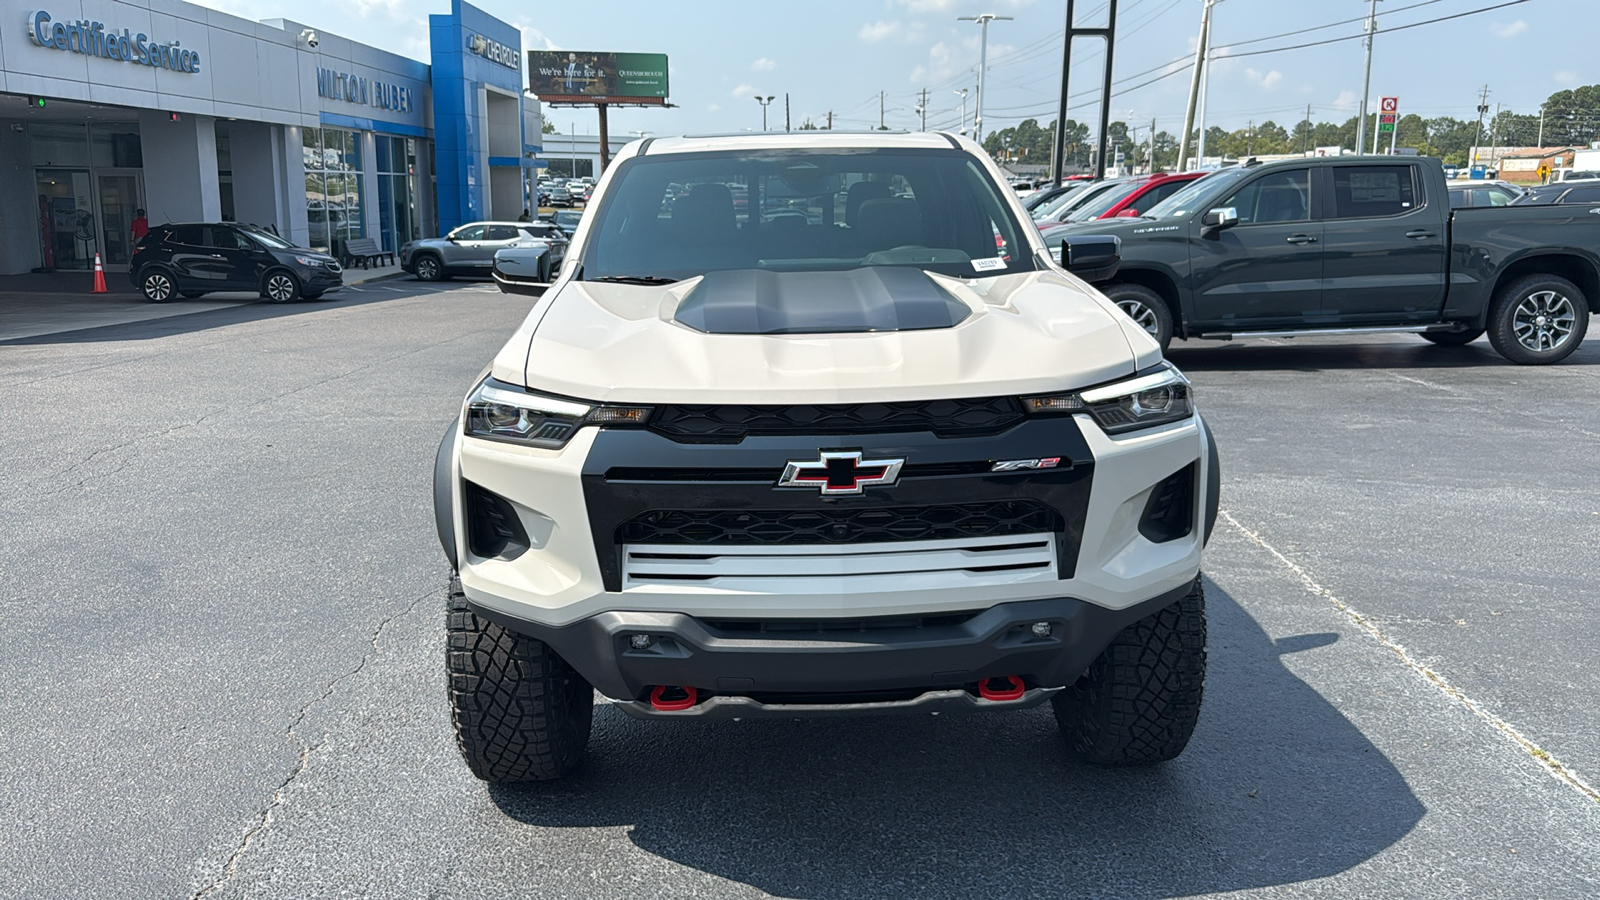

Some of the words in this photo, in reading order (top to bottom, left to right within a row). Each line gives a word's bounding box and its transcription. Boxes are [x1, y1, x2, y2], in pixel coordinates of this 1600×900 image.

[29, 10, 131, 62] Certified
[132, 33, 201, 73] Service
[487, 38, 520, 69] CHEVROLET
[539, 67, 562, 76] We're
[584, 69, 596, 77] for
[598, 69, 606, 77] it.
[316, 66, 368, 105] MILTON
[371, 80, 413, 113] RUBEN
[991, 457, 1061, 472] ZR2
